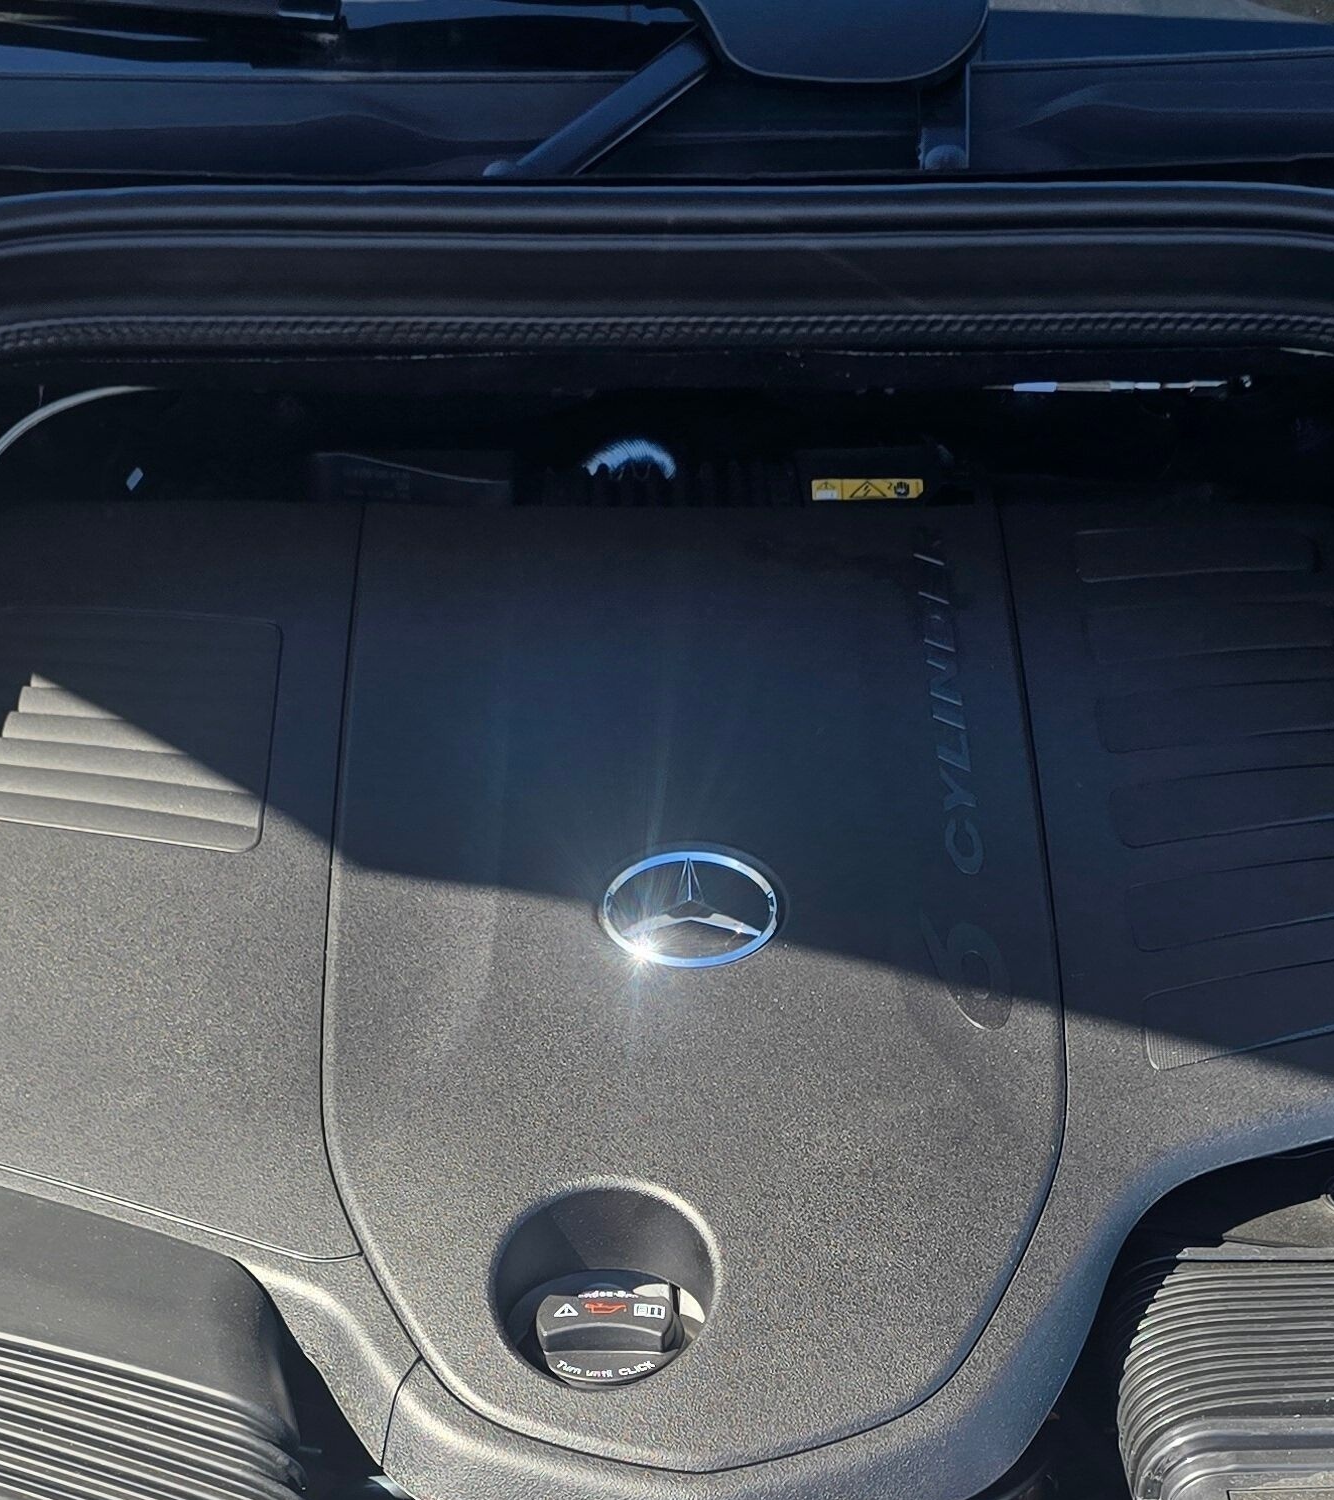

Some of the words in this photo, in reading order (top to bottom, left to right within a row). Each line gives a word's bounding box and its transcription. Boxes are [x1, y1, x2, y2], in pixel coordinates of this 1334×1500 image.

[919, 906, 1013, 1031] 6
[556, 1360, 582, 1375] Turn
[618, 1360, 656, 1376] CLICK
